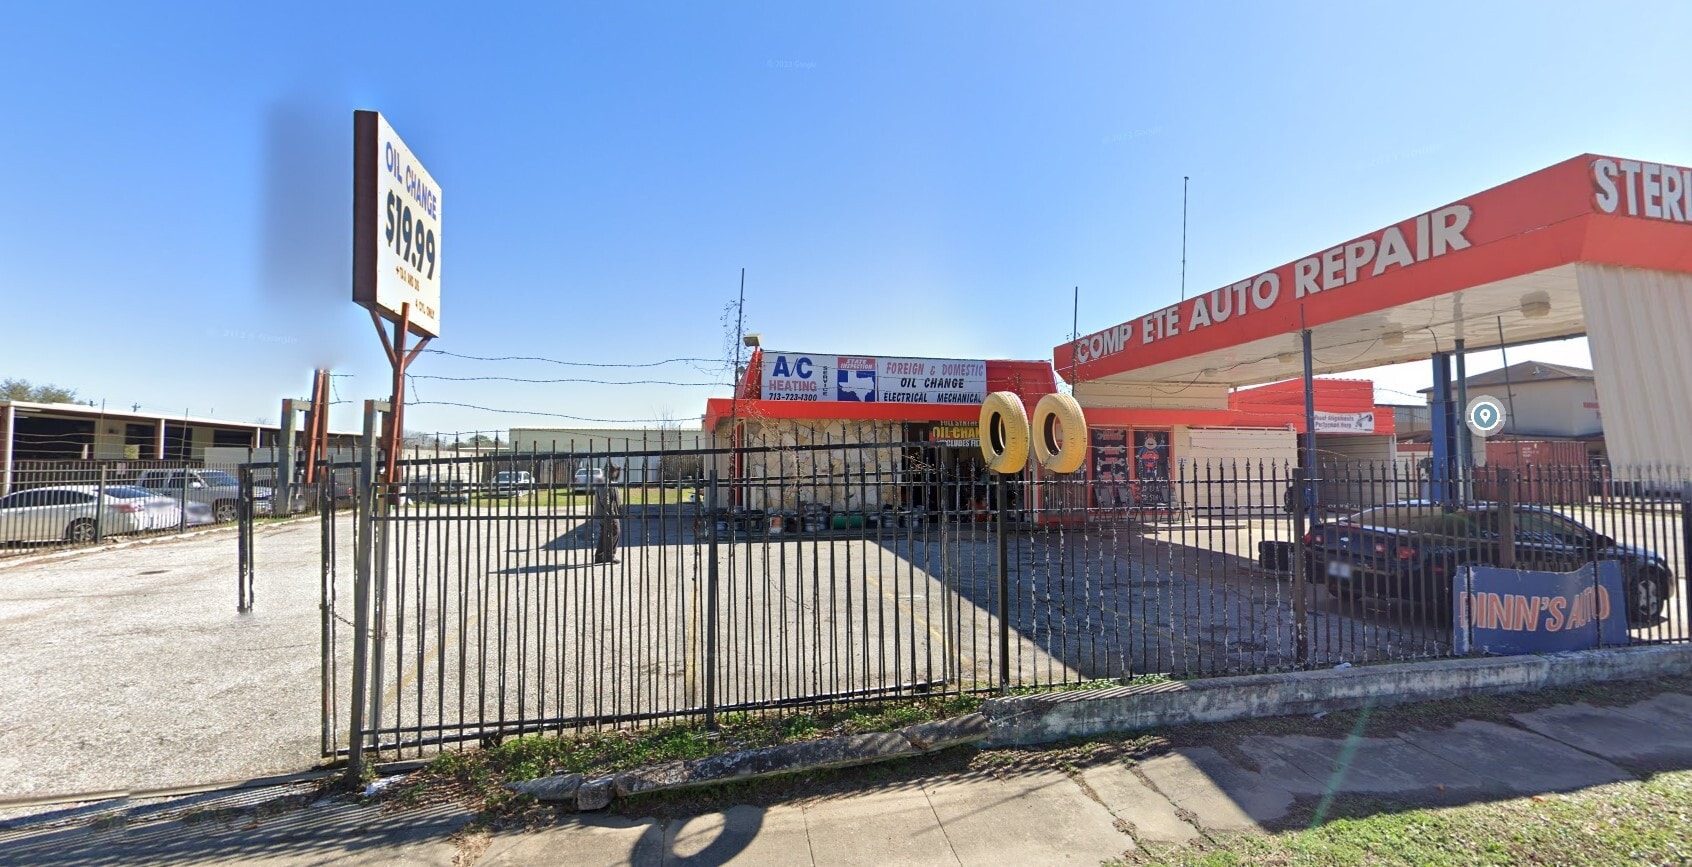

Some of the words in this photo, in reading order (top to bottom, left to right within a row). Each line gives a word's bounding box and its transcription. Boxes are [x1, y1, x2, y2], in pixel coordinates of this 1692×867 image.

[385, 141, 403, 185] OIL
[405, 164, 437, 221] CHANGE
[385, 188, 436, 281] $19.99
[1188, 271, 1280, 332] AUTO
[1295, 203, 1473, 299] REPAIR
[772, 355, 813, 379] A/C
[886, 362, 925, 376] FOREIGN
[929, 365, 936, 376] &
[942, 363, 984, 377] DOMESTIC
[768, 380, 818, 392] HEATING
[900, 377, 917, 389] OIL
[924, 377, 965, 389] CHANGE
[768, 392, 818, 402] 713-723-1300
[883, 392, 928, 403] ELECTRICAL
[936, 392, 982, 403] MECHANICAL
[932, 426, 951, 439] OIL
[1459, 591, 1567, 632] DINN'S
[1565, 584, 1611, 630] AUTO
